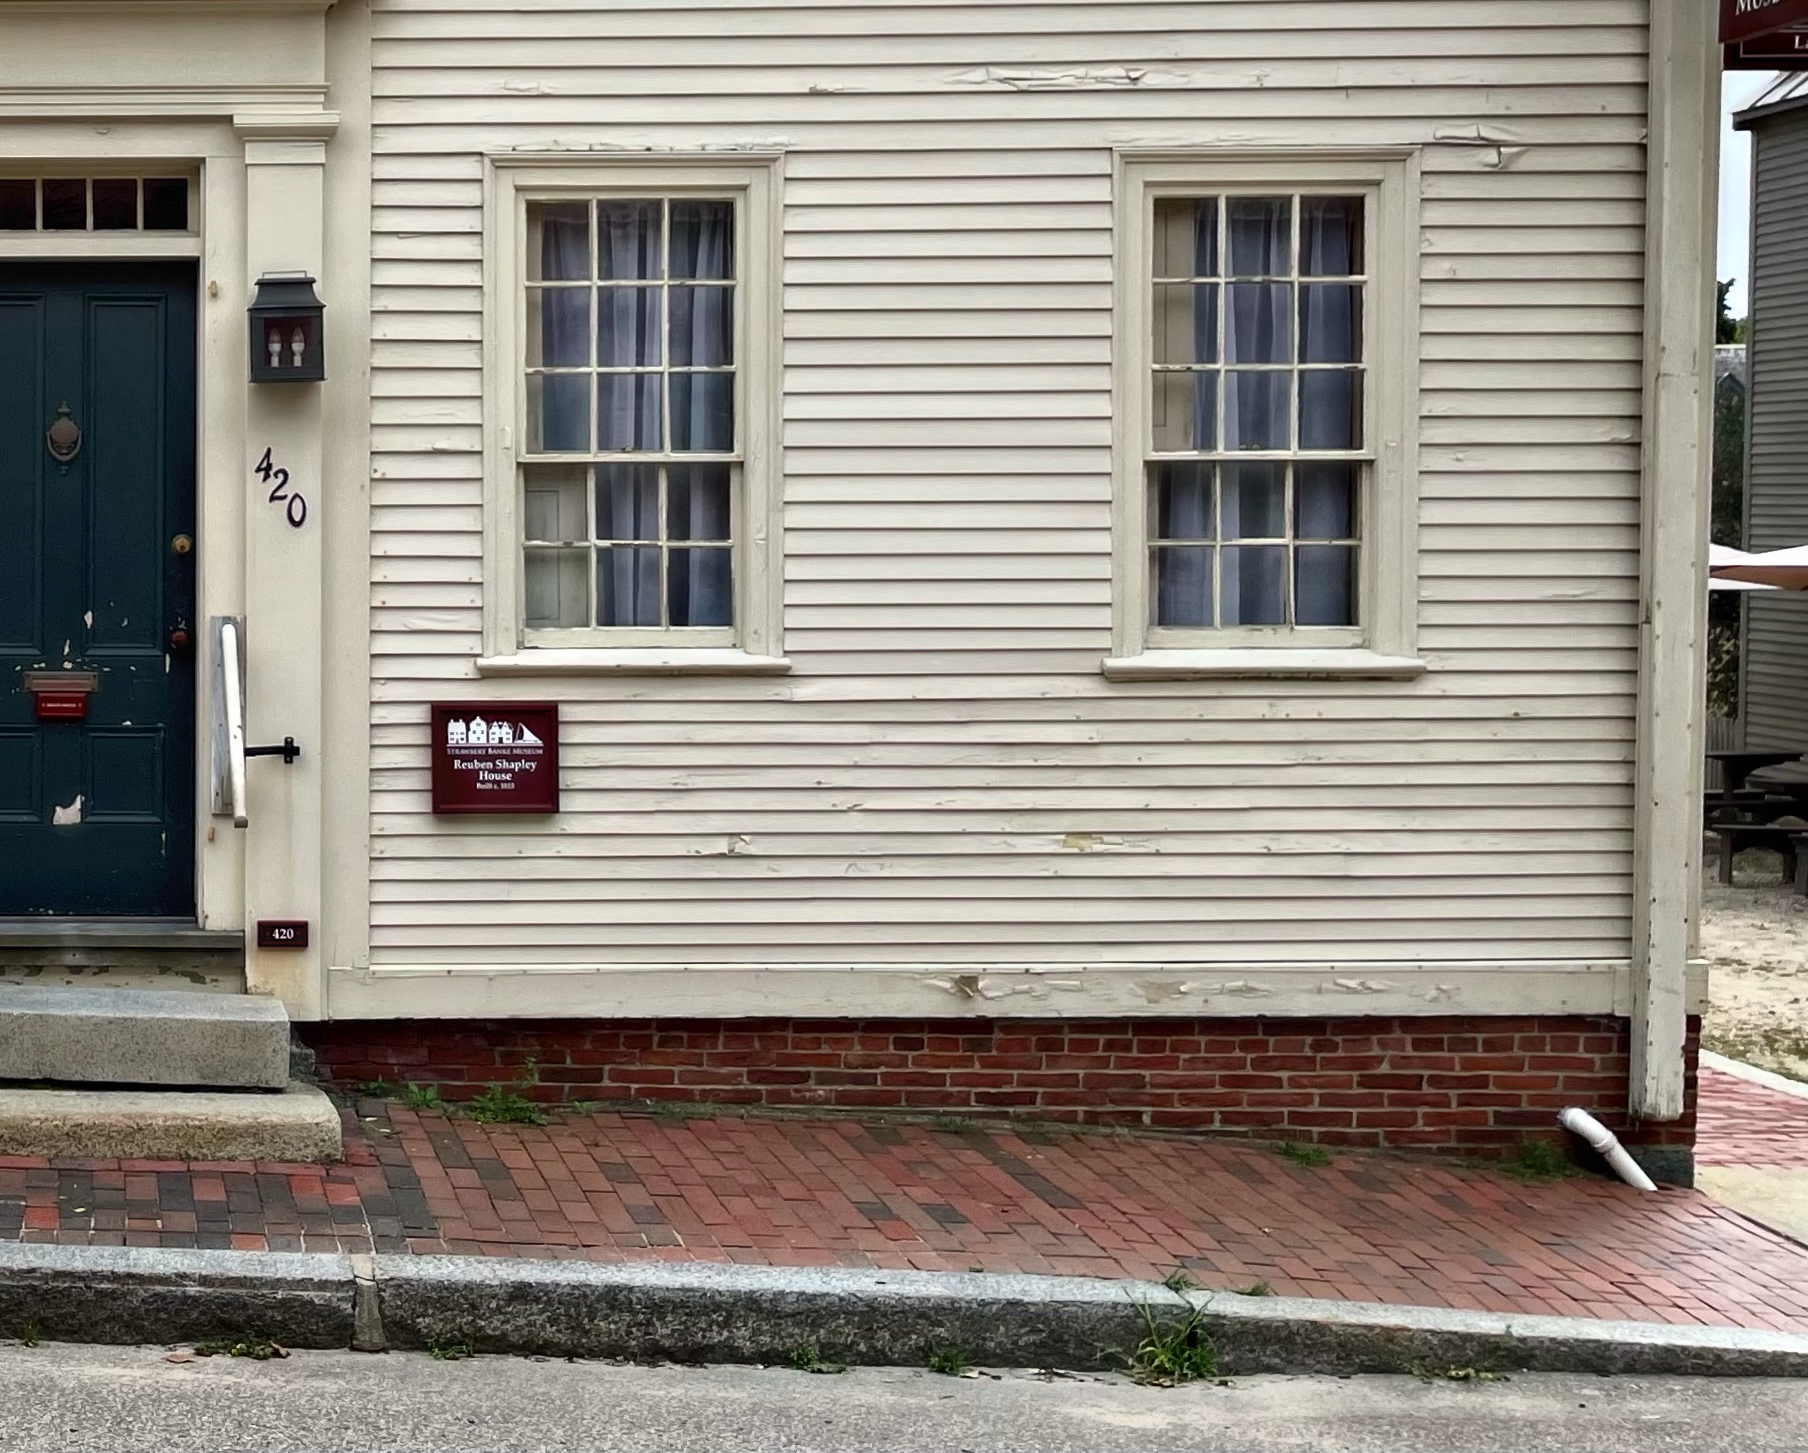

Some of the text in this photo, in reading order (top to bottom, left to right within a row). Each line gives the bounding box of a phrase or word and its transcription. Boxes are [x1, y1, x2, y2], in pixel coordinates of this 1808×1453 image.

[254, 446, 307, 528] 420
[453, 758, 538, 772] Reuben Shapley
[478, 770, 513, 781] House
[272, 928, 295, 940] 420
